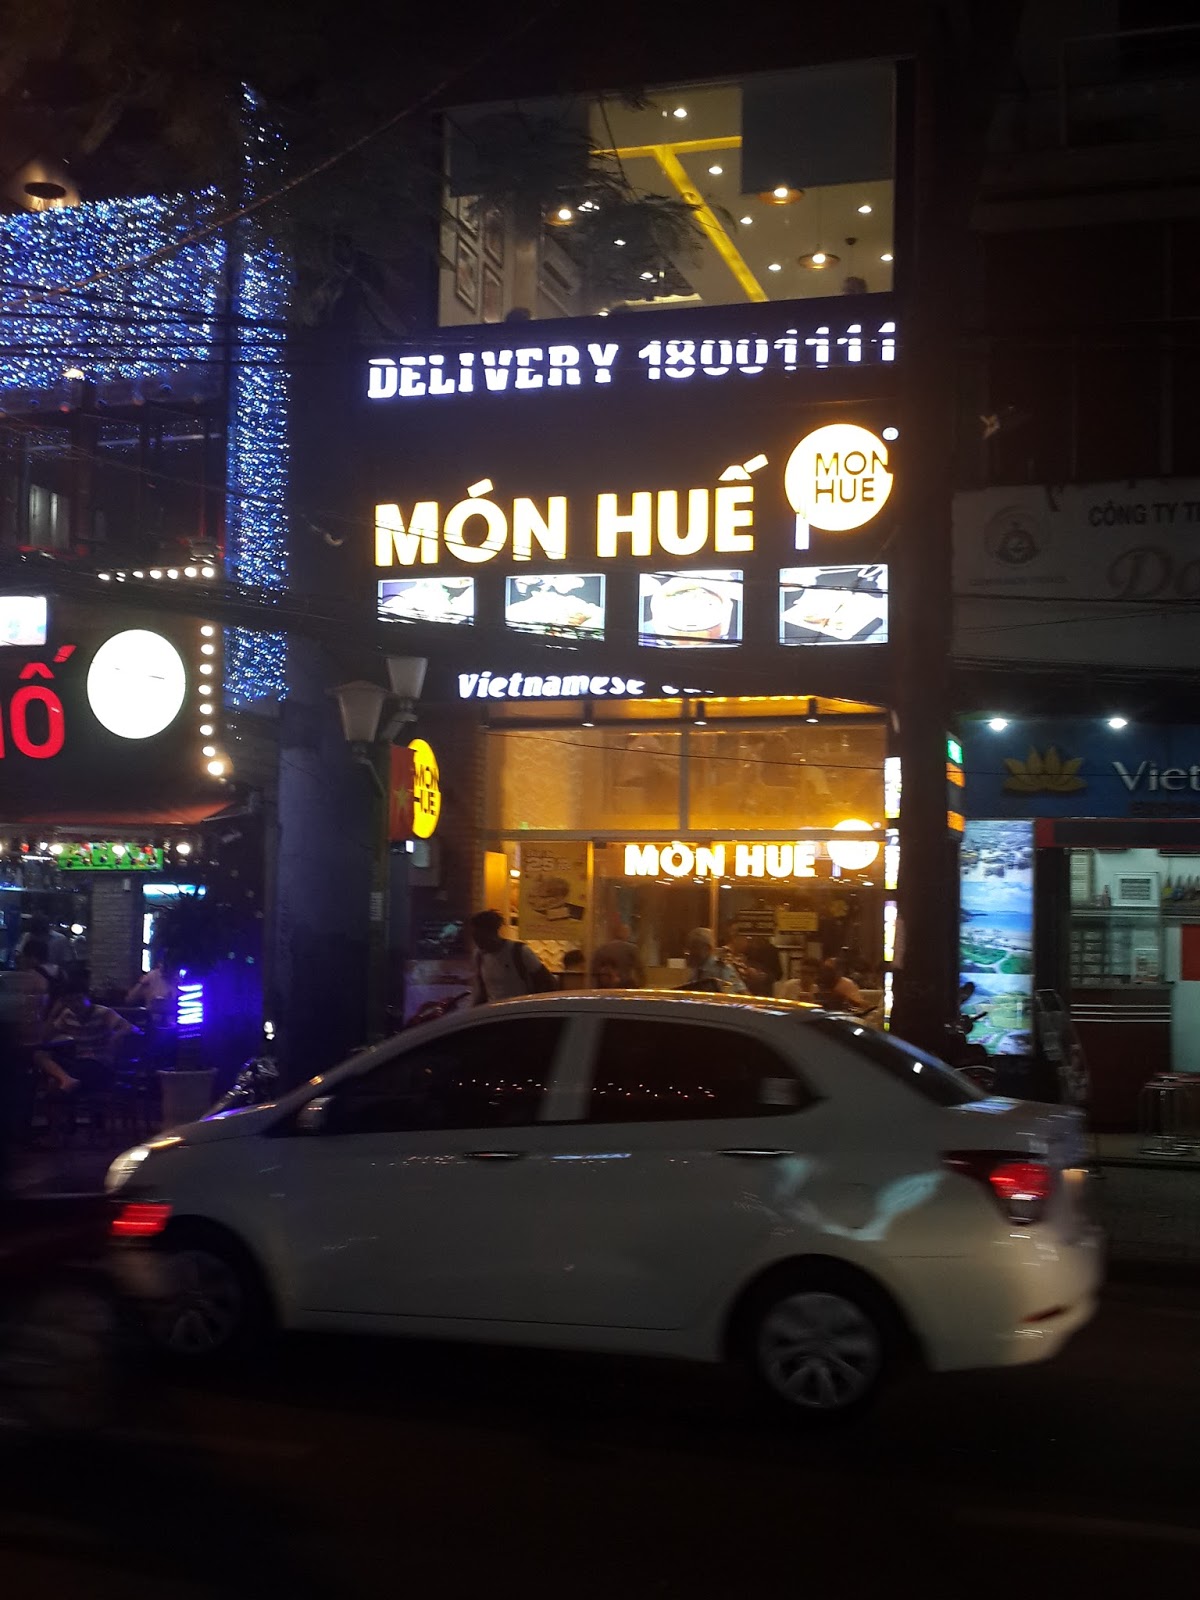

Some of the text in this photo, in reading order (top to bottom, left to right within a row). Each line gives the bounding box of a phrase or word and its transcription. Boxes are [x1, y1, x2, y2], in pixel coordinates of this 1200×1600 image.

[367, 343, 619, 399] DELIVERY
[815, 477, 875, 504] HUE
[374, 453, 769, 567] MÓN HUẾ
[1087, 499, 1147, 527] CÔNG
[1152, 501, 1178, 525] TY
[457, 670, 647, 699] Vietnamese
